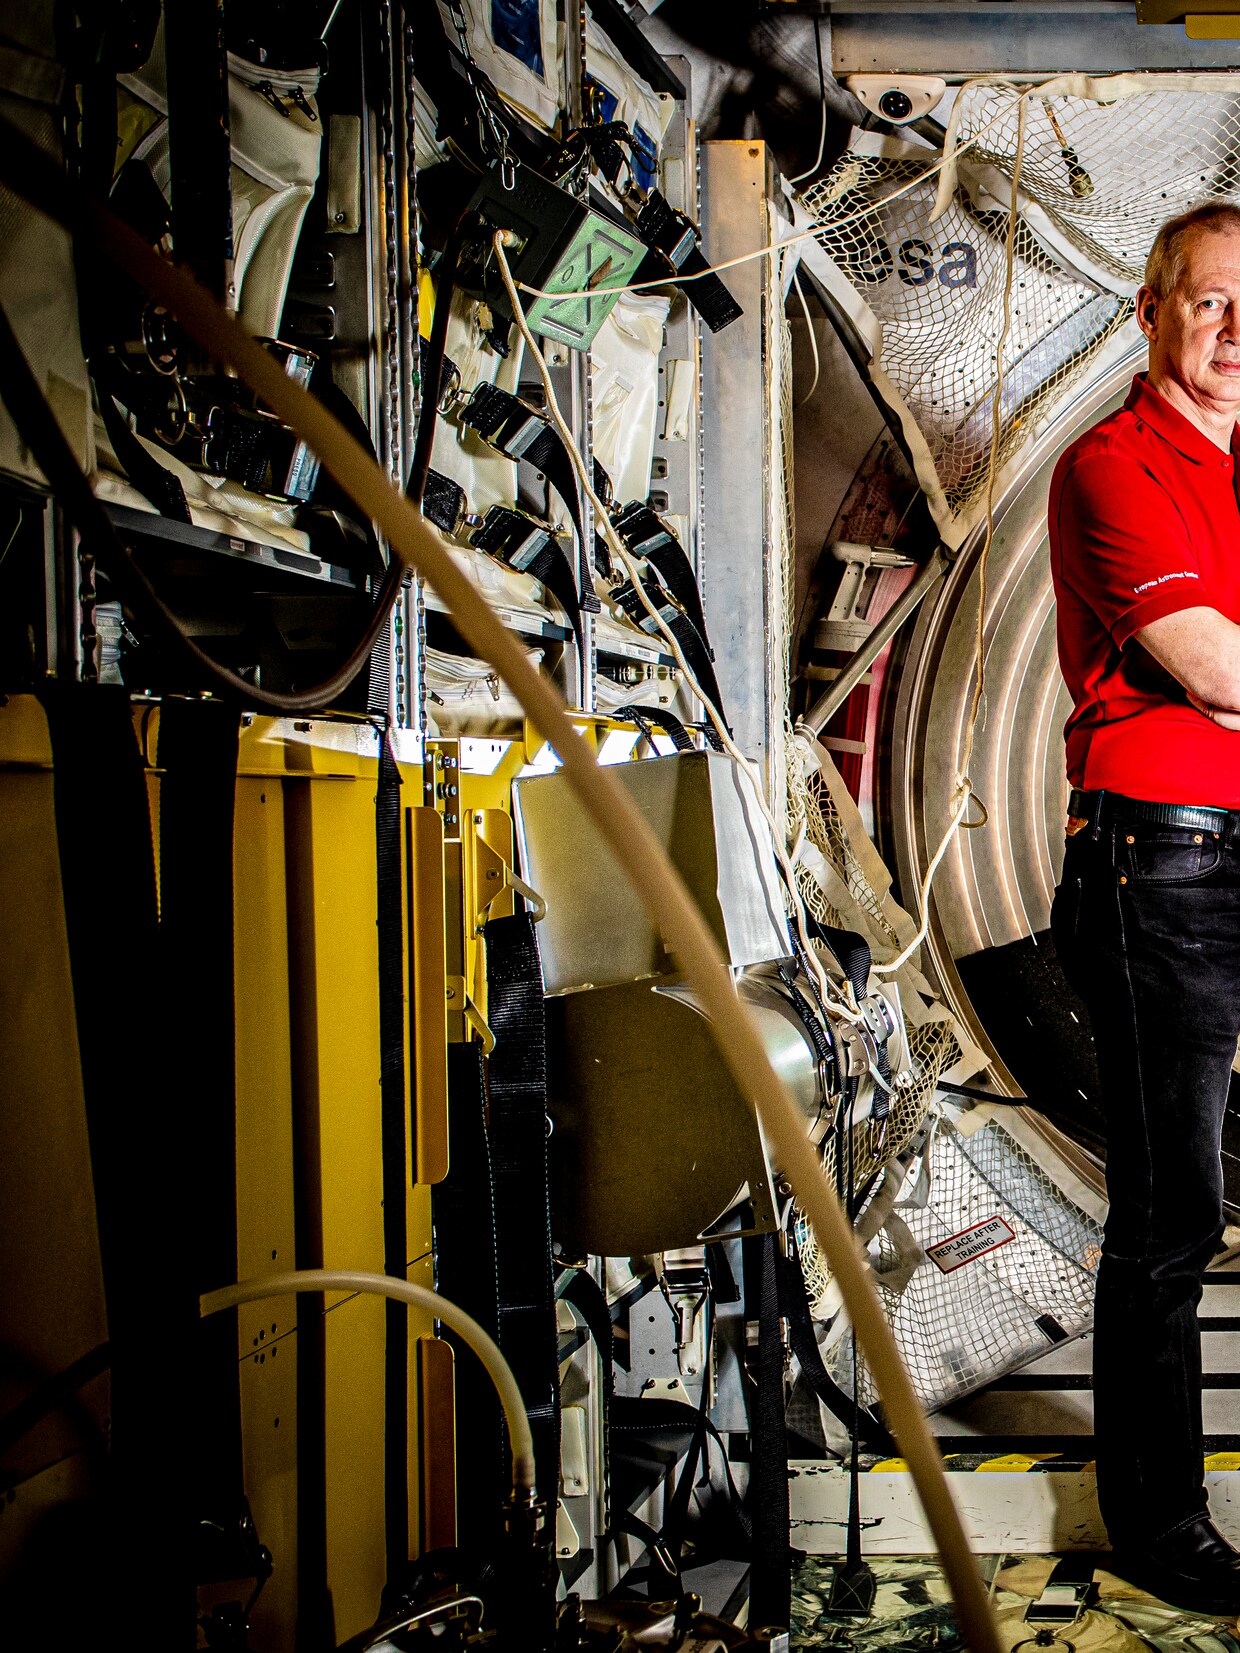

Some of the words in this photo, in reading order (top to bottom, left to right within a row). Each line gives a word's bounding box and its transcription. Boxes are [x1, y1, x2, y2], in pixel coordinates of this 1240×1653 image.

[850, 236, 977, 288] esa
[934, 1234, 974, 1259] REPLACE
[973, 1221, 1001, 1240] AFTER
[955, 1237, 995, 1261] TRAINING
